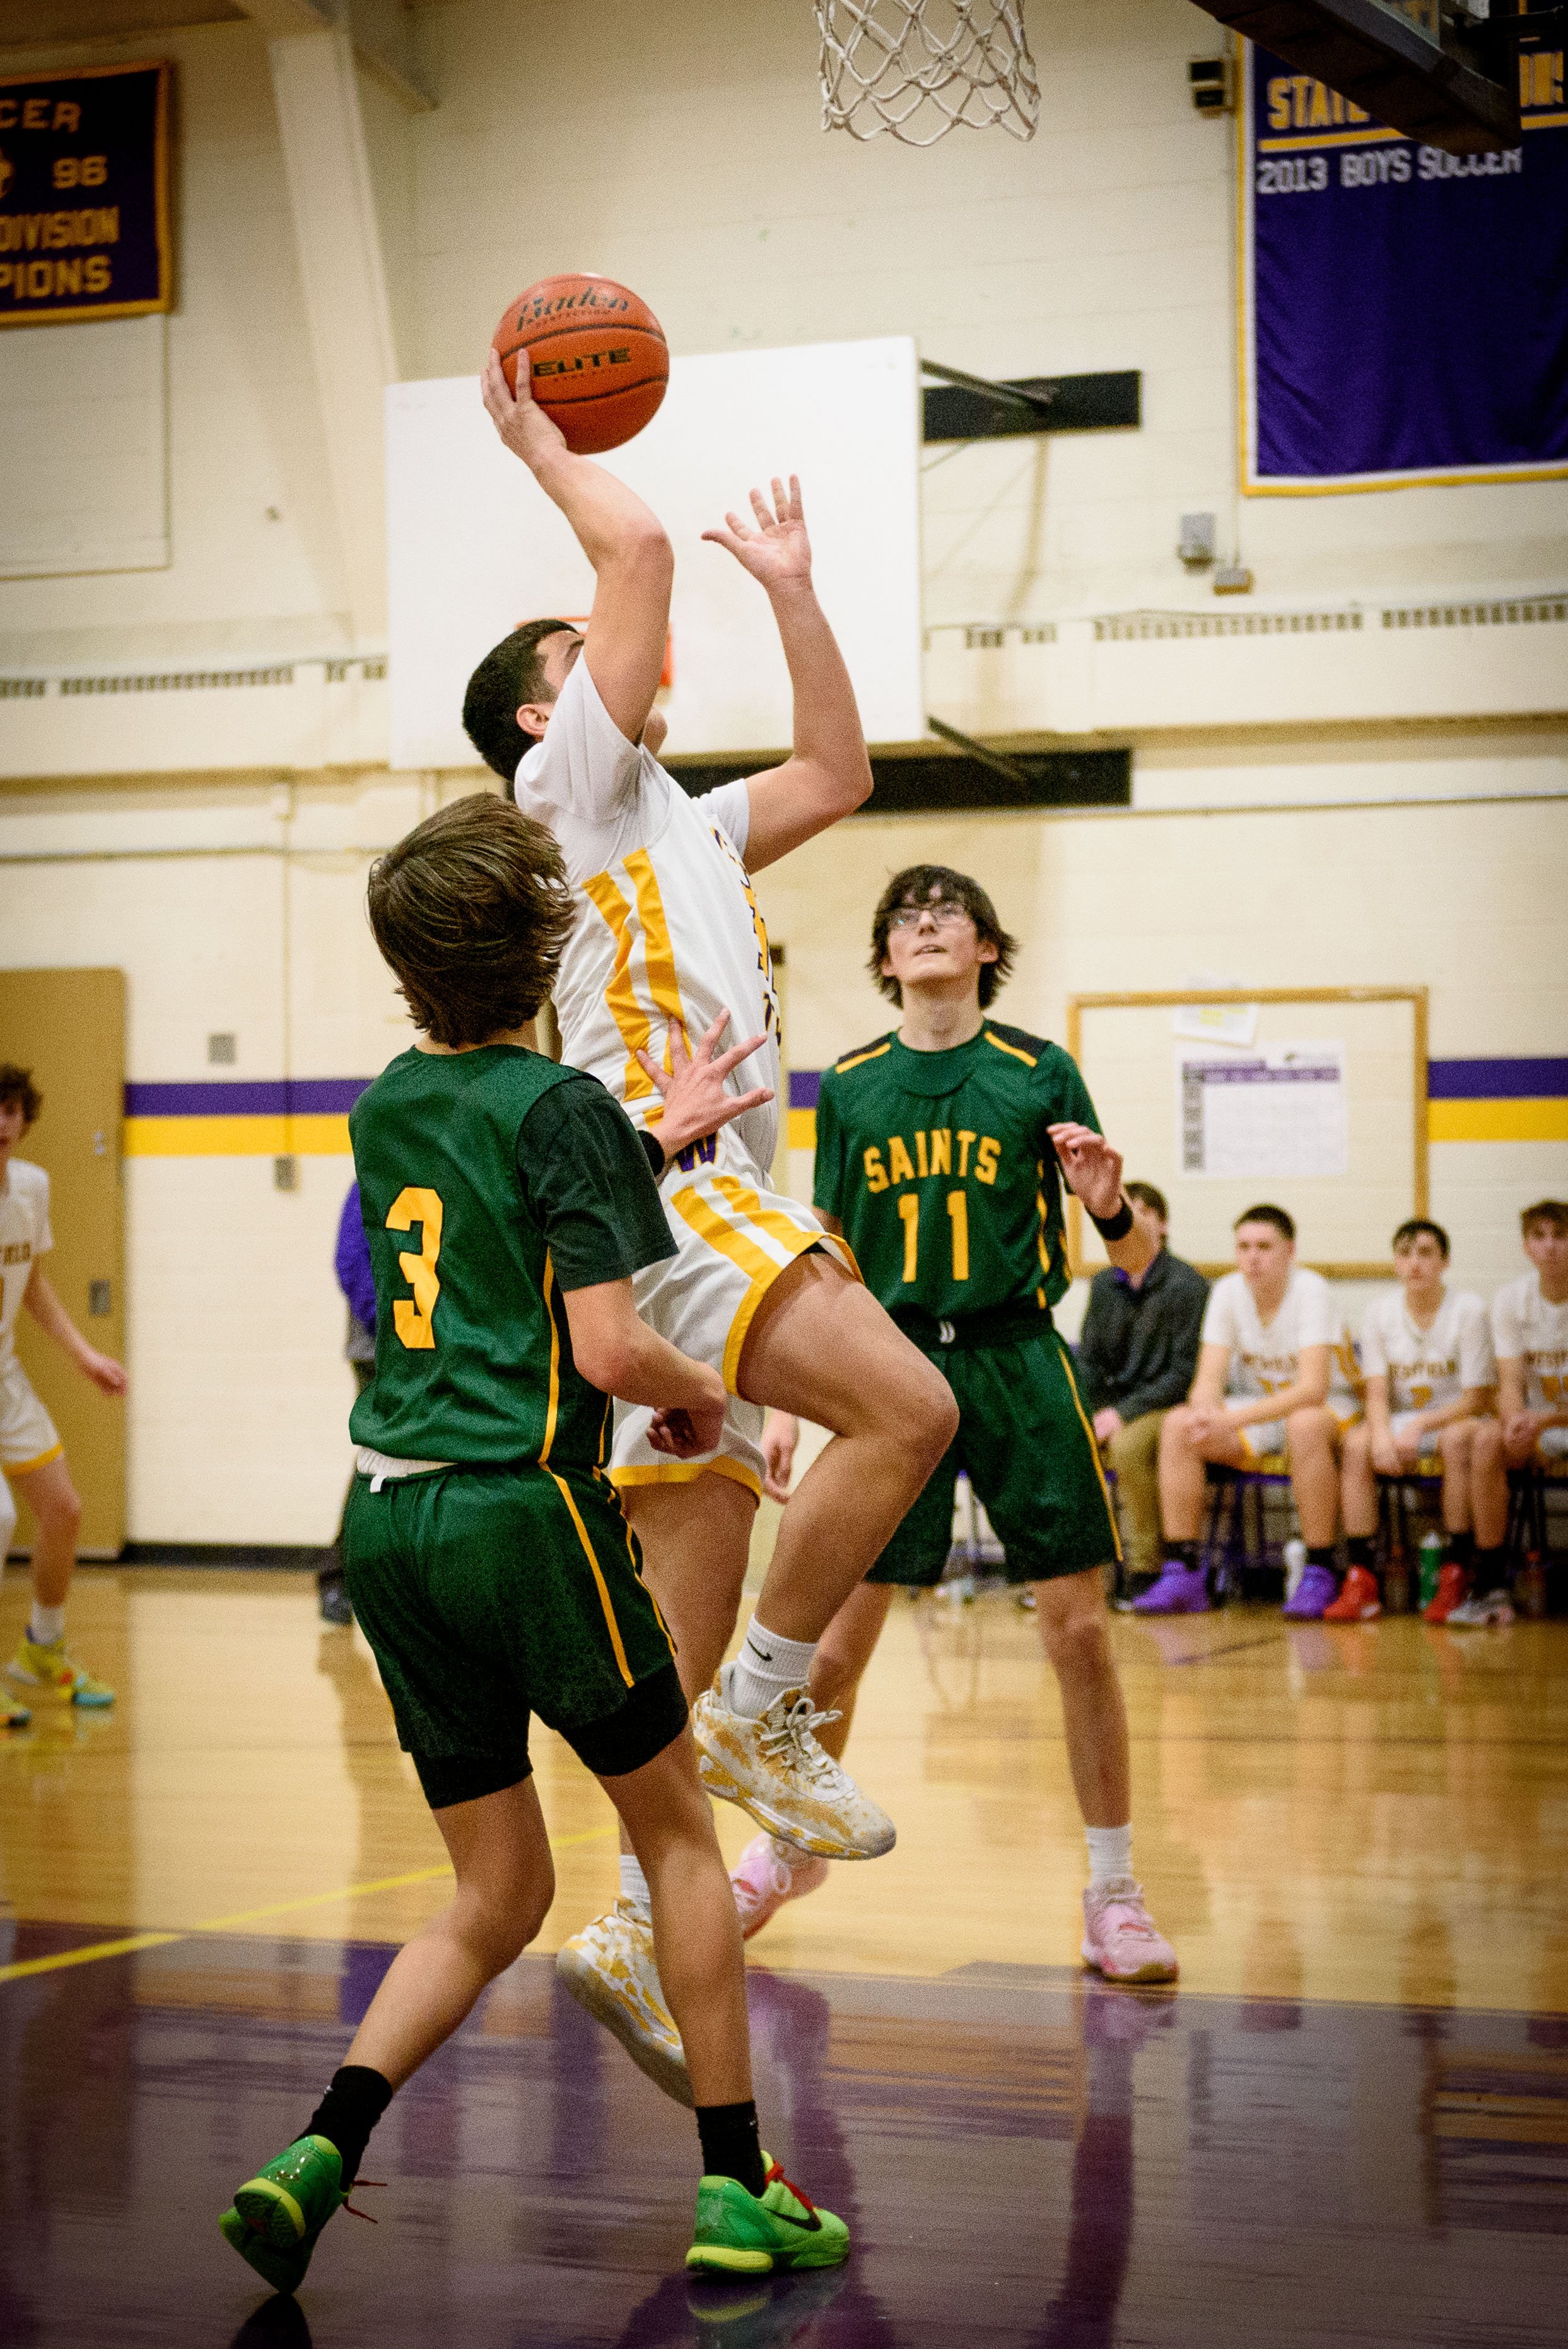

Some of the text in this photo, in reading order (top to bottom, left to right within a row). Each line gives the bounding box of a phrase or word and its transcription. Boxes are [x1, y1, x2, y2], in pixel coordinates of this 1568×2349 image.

[52, 155, 108, 189] 96
[1257, 157, 1328, 194] 2013
[1340, 147, 1412, 187] BOYS
[532, 348, 631, 377] ELITE
[863, 1127, 1002, 1194] SAINTS
[898, 1190, 969, 1284] 11
[385, 1186, 443, 1350] 3
